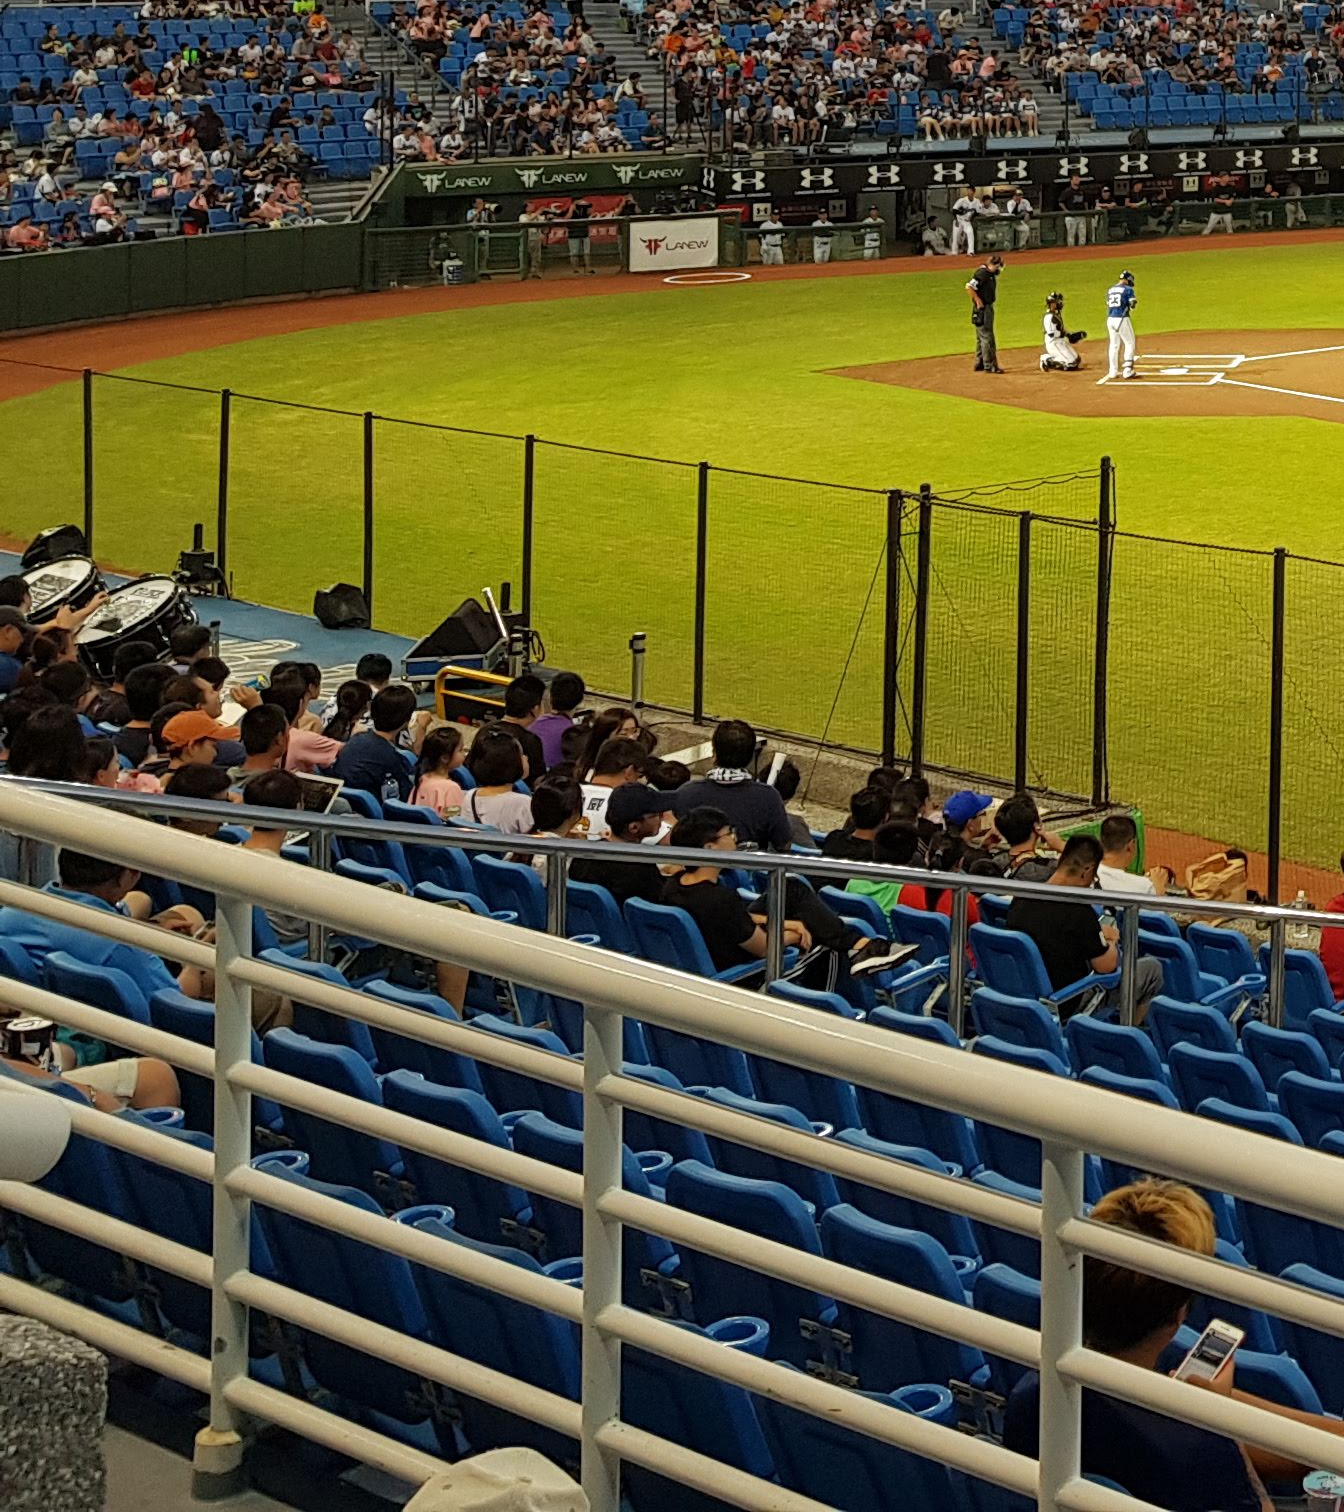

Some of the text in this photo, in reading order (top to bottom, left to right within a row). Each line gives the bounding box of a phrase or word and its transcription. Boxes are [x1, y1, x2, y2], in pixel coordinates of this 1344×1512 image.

[542, 172, 588, 185] LANEW
[638, 168, 684, 180] LANEW
[445, 175, 492, 189] LANEW
[665, 239, 709, 251] LANEW
